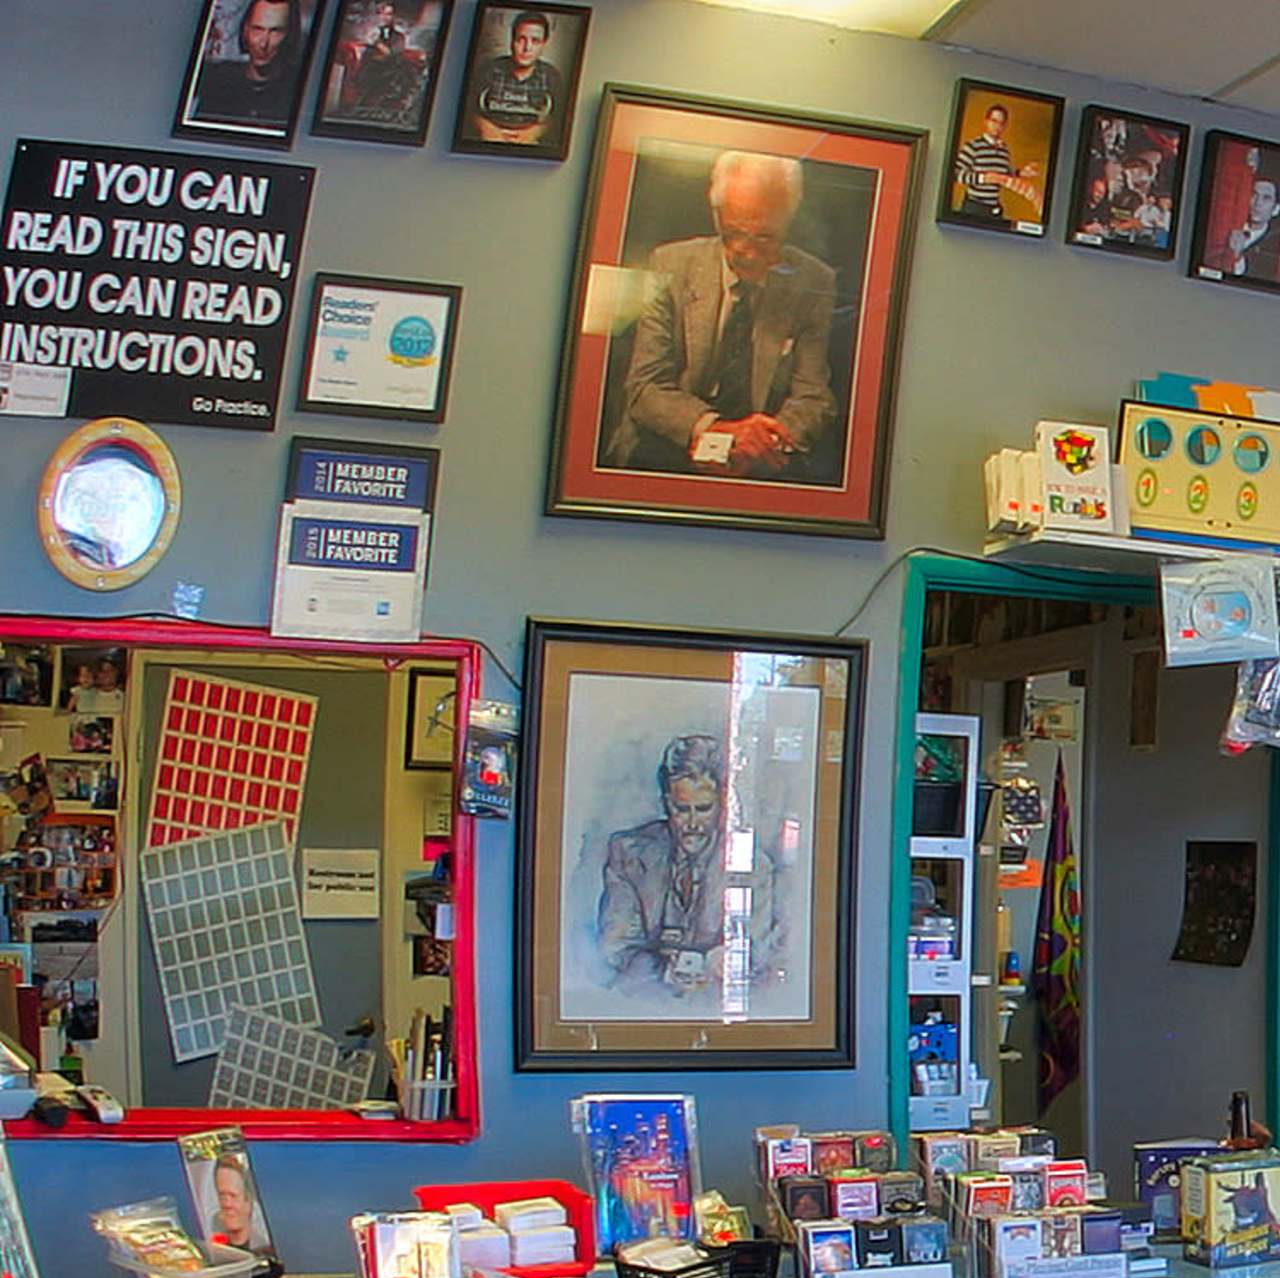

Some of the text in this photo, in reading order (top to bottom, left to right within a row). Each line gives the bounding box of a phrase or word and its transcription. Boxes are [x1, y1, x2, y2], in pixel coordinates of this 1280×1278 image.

[53, 159, 269, 216] IF YOU CAN
[7, 211, 292, 280] READ THIS SIGN,
[2, 266, 282, 326] YOU CAN READ
[322, 309, 373, 326] Choice
[0, 322, 263, 381] INSTRUCTIONS.
[192, 397, 212, 413] Go
[334, 461, 409, 483] MEMBER
[333, 479, 406, 500] FAVORITE
[326, 528, 400, 548] MEMBER
[325, 544, 399, 564] FAVORITE
